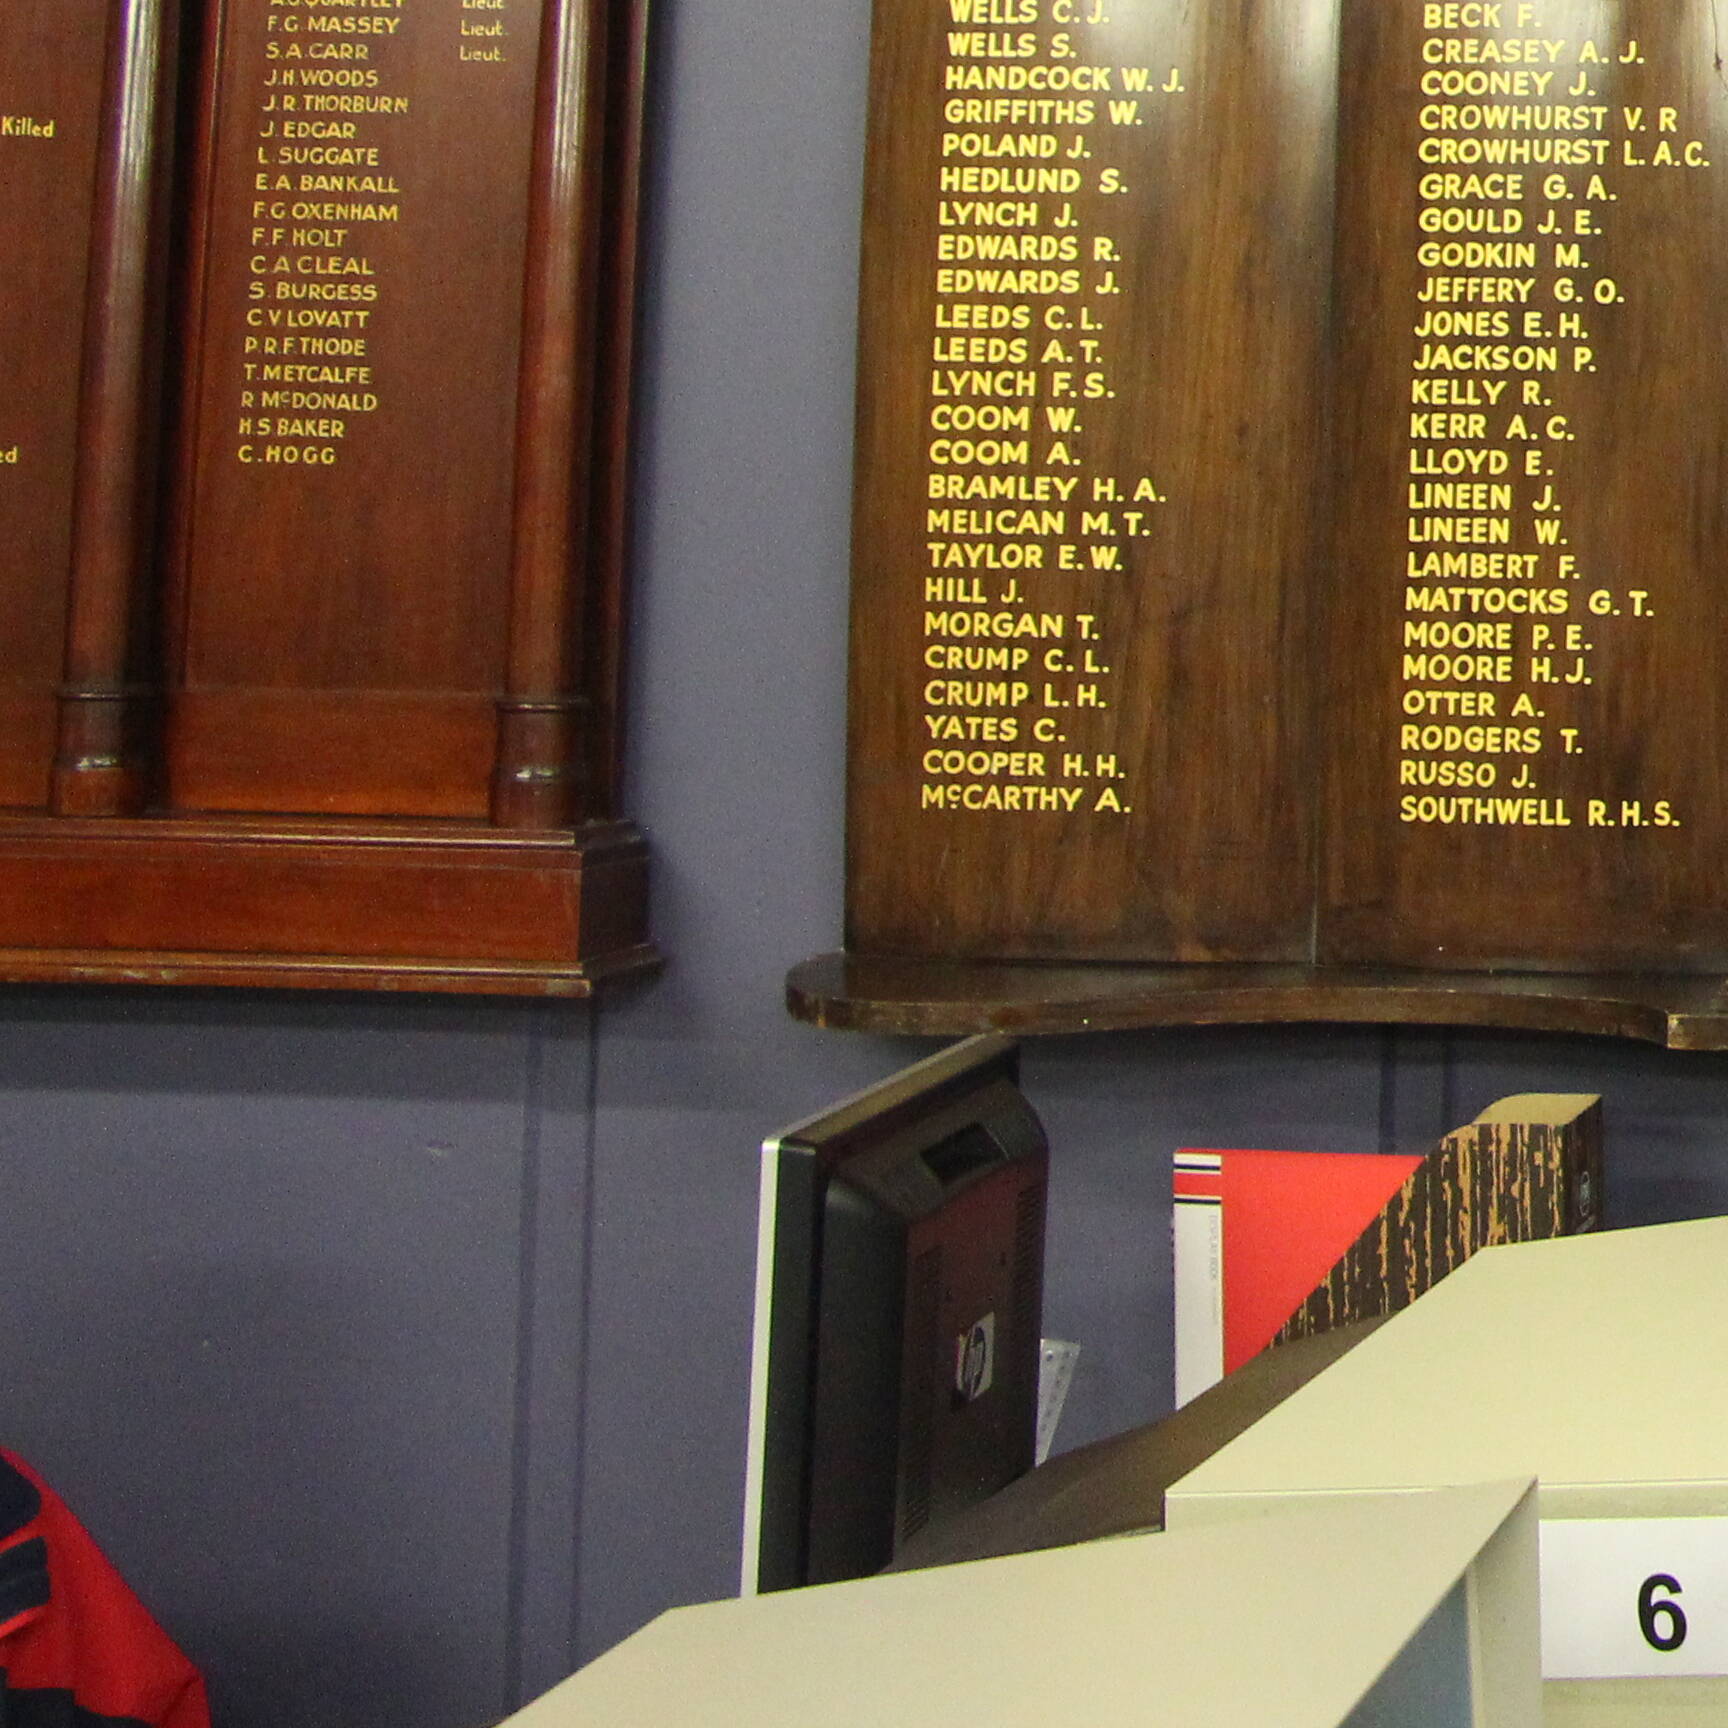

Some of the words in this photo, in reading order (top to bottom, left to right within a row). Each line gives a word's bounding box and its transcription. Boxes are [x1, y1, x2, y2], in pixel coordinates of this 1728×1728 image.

[1424, 3, 1503, 28] BECK
[1518, 4, 1540, 27] F.
[949, 32, 1038, 56] WELLS
[1051, 33, 1077, 57] S.
[1421, 70, 1553, 95] COONEY
[1569, 72, 1596, 96] J.
[945, 99, 1095, 123] GRIFFITHS
[1109, 101, 1141, 124] W.
[2, 117, 53, 138] Killed
[283, 122, 356, 138] EDGAR
[279, 148, 379, 166] SUGGATE
[943, 133, 1060, 157] POLAND
[1066, 136, 1091, 158] J.
[1418, 242, 1536, 267] GODKIN
[1556, 244, 1590, 267] M.
[277, 283, 378, 301] BURGESS
[266, 445, 336, 464] HOGG
[1410, 449, 1509, 474] LLOYD
[1526, 450, 1554, 475] E.
[1408, 552, 1540, 578] LAMBERT
[1559, 555, 1581, 578] F.
[925, 577, 988, 603] HILL
[1001, 579, 1024, 603] J.
[925, 716, 1018, 741] YATES
[1034, 718, 1067, 741] C.
[1402, 724, 1542, 753] RODGERS
[1560, 729, 1583, 752] T.
[923, 784, 1083, 811] McCARTHY
[1637, 1573, 1688, 1651] 6
